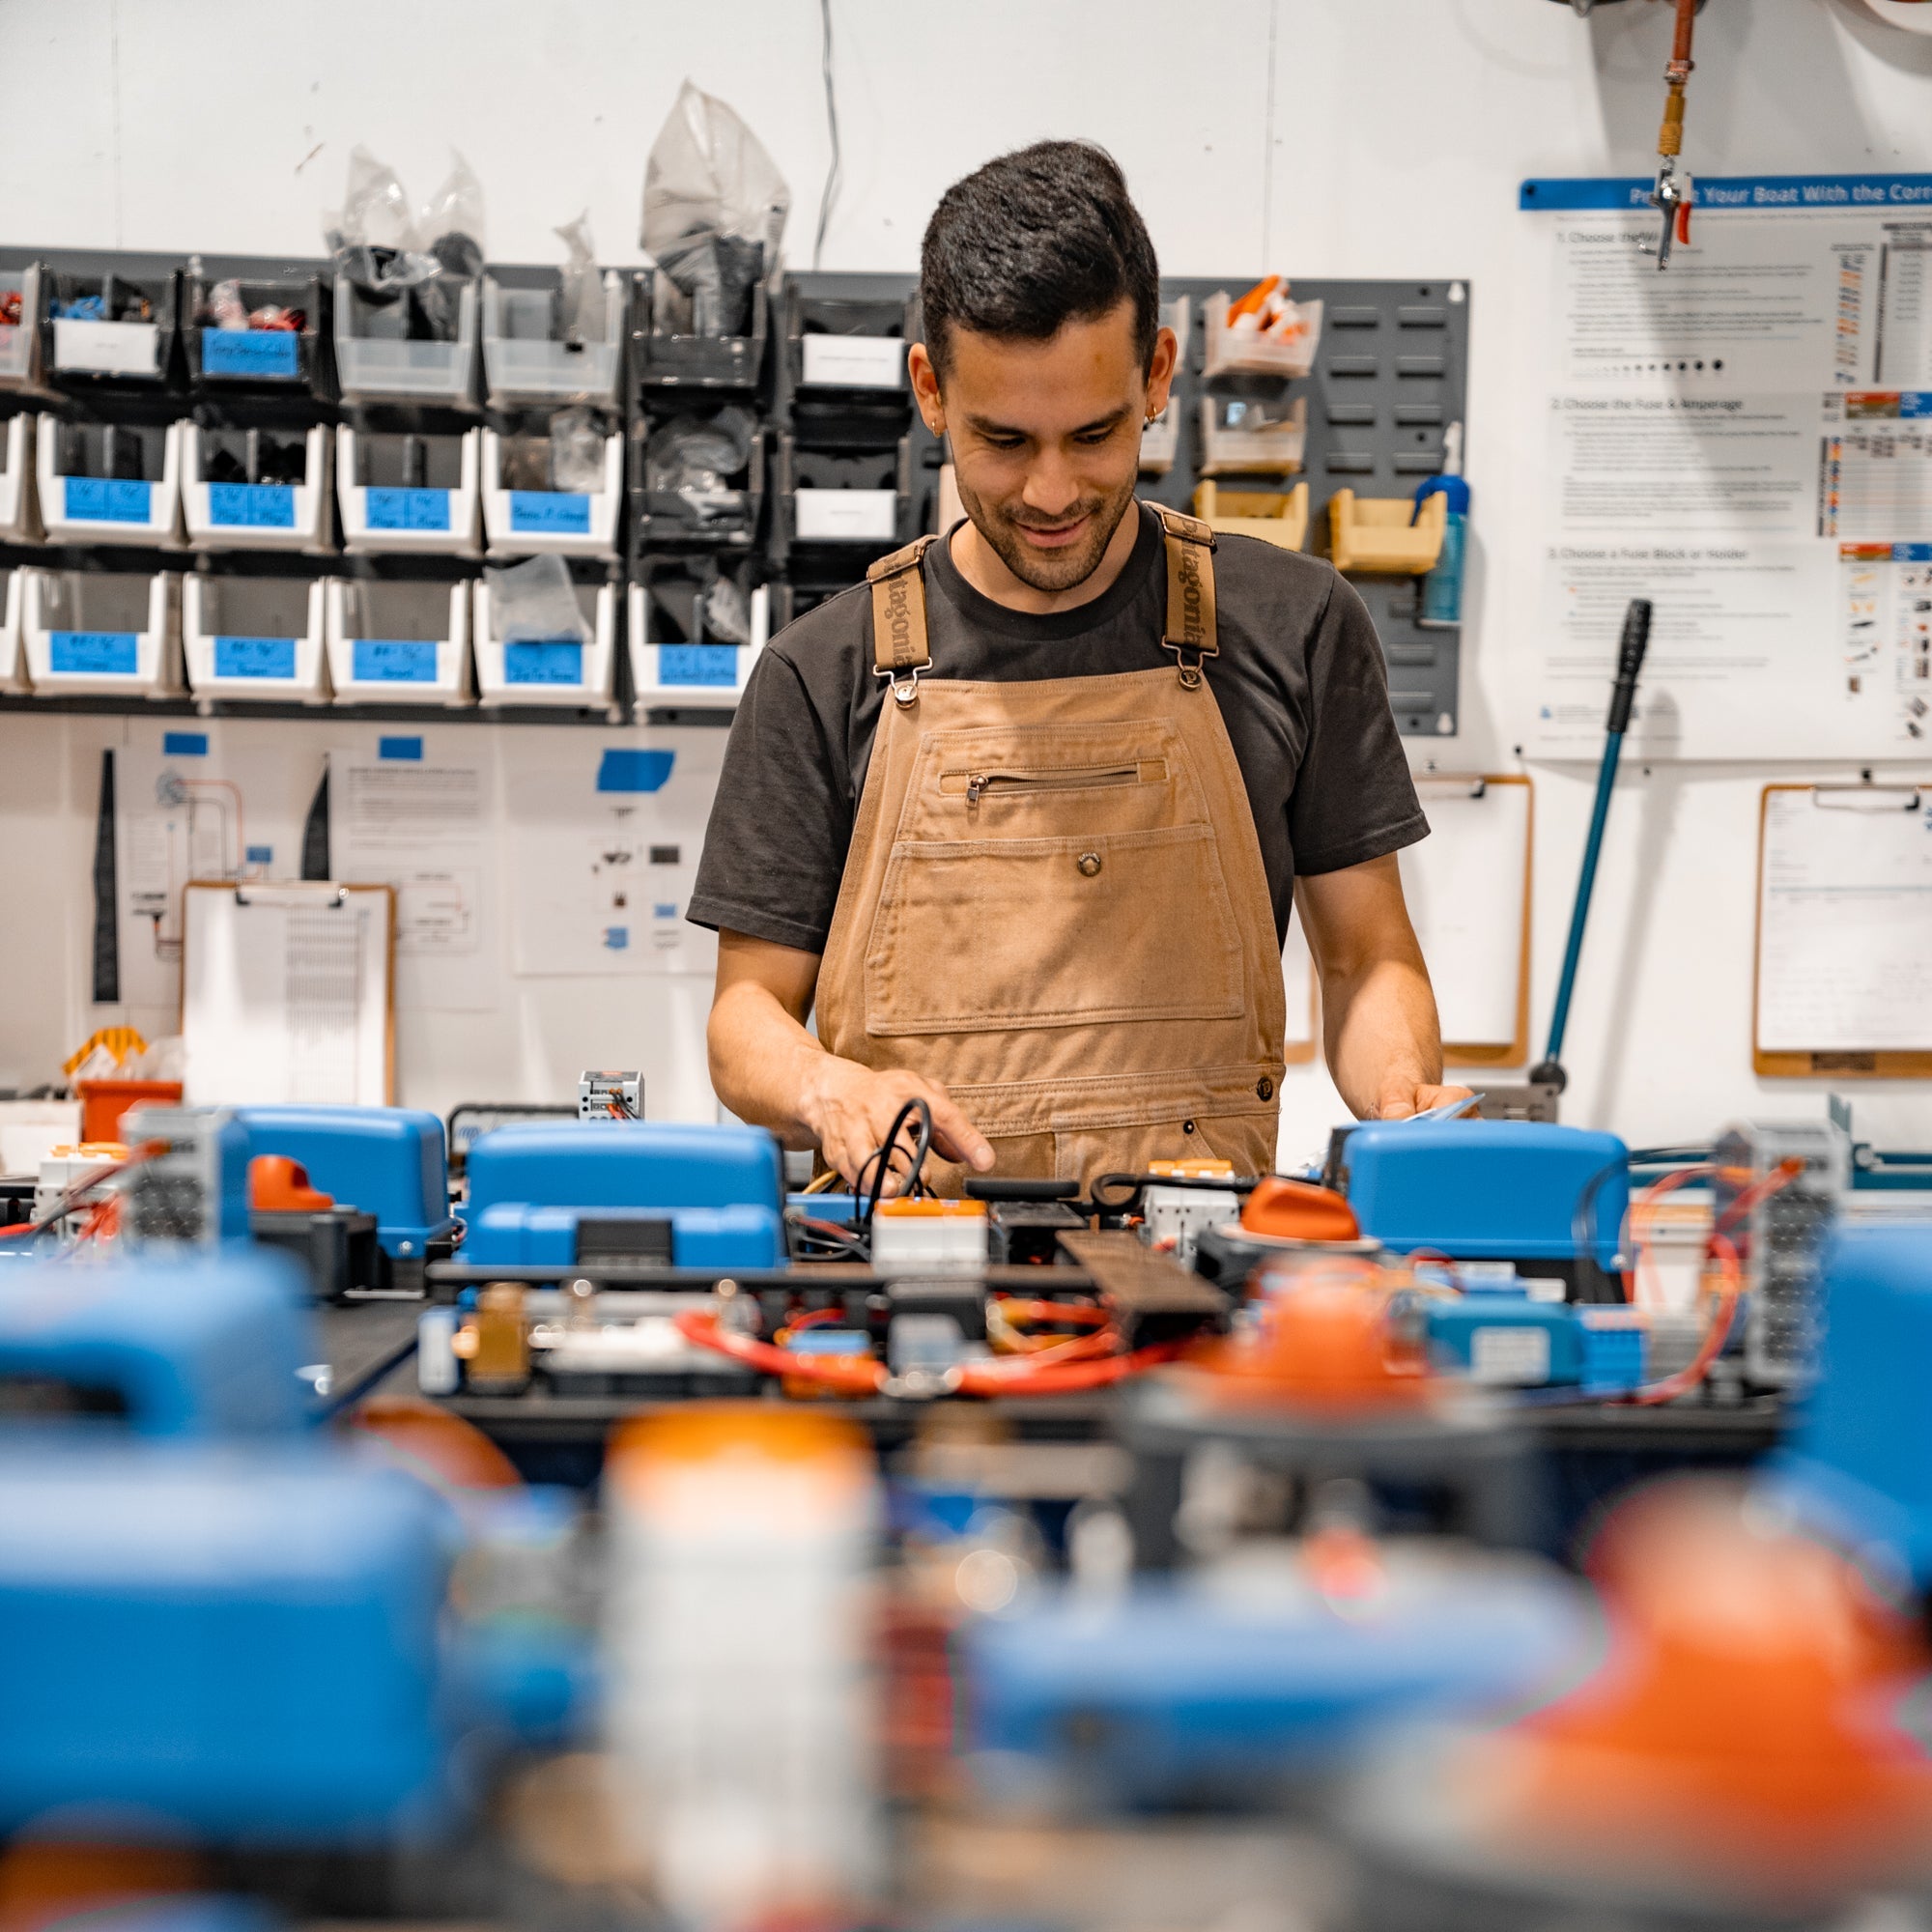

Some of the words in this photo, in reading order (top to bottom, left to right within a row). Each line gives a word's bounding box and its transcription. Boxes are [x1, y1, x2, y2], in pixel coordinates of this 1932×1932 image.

[1703, 186, 1750, 204] Your
[1753, 185, 1799, 203] Boat
[1803, 185, 1849, 202] With
[1852, 184, 1886, 201] the
